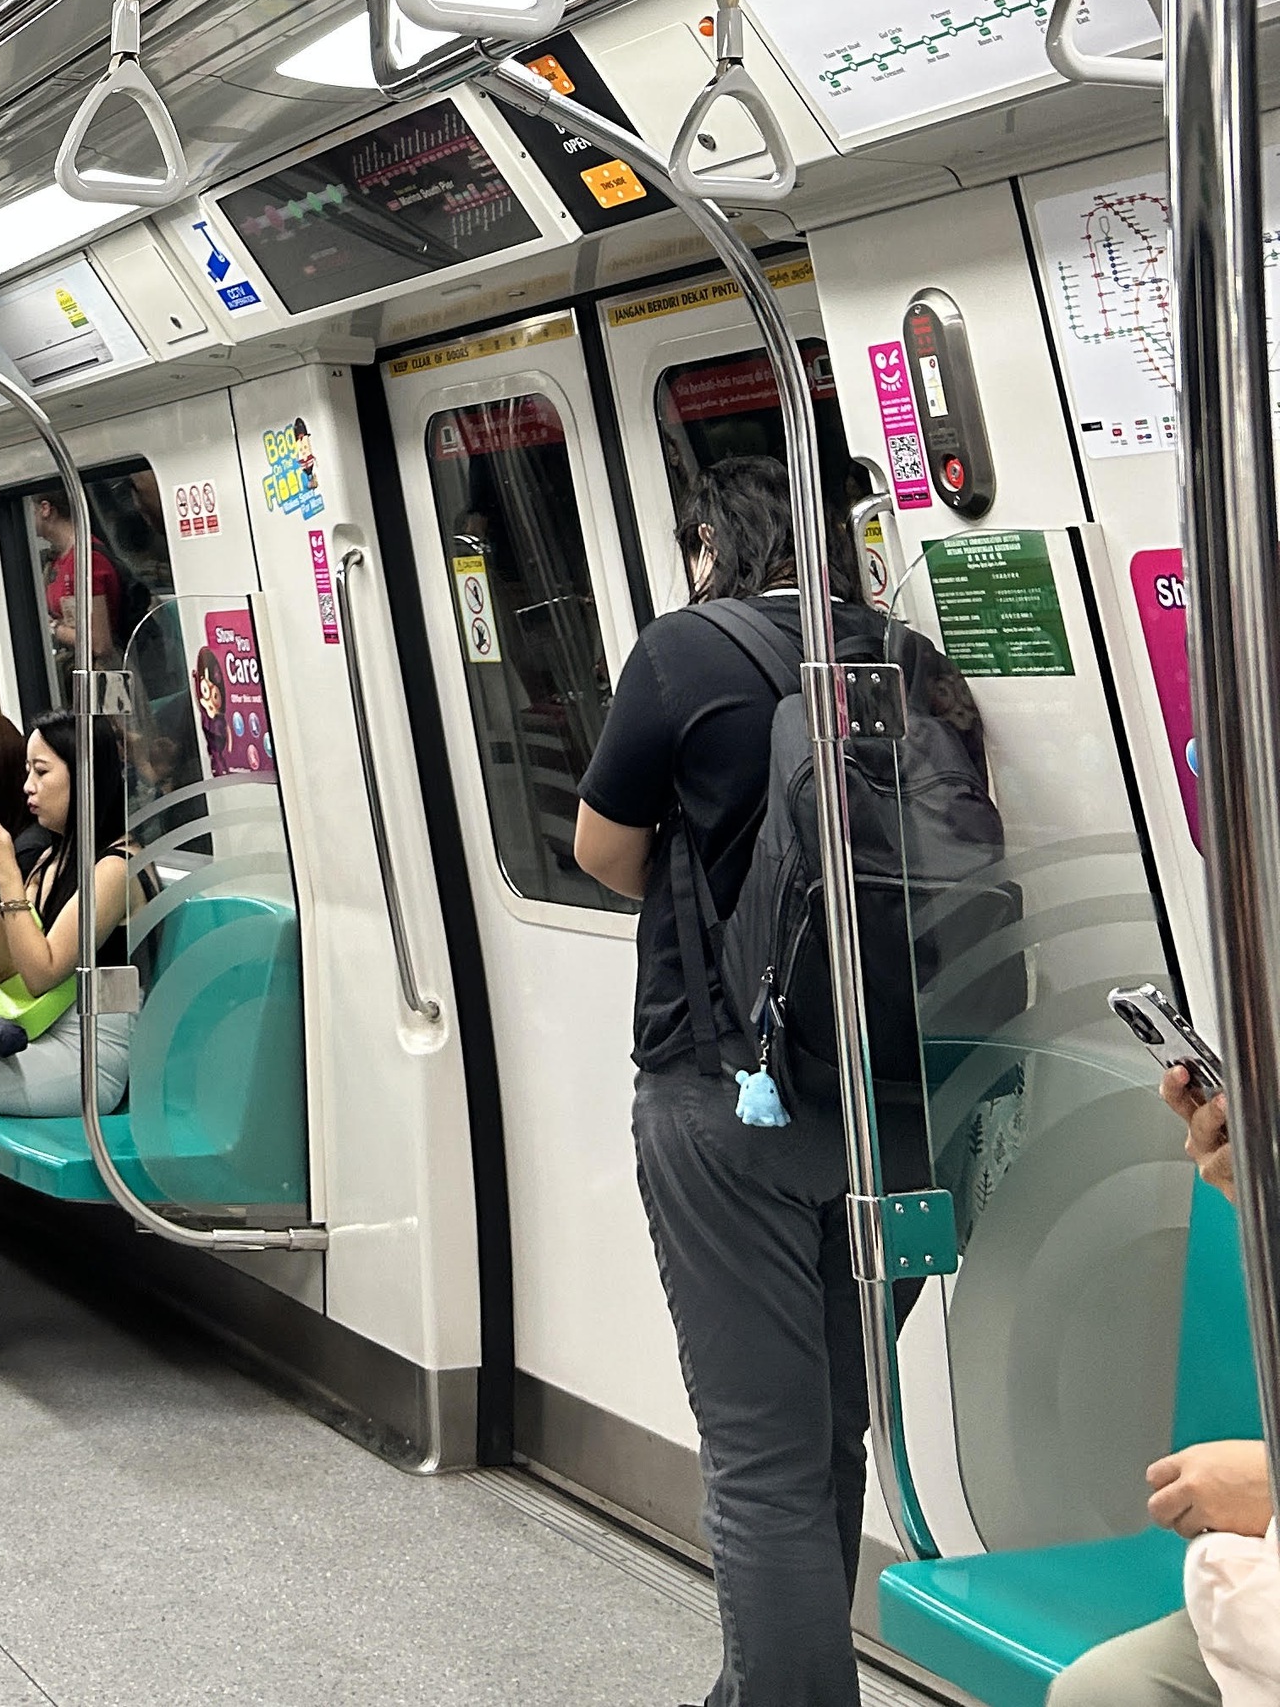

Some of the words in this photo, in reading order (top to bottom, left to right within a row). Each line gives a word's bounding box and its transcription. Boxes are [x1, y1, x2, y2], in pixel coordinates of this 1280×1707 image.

[226, 285, 246, 300] CCTV
[614, 305, 646, 324] JANGAN
[647, 297, 680, 314] BERDIRI
[681, 288, 710, 306] DEKAT
[711, 281, 740, 298] PINTU
[411, 356, 432, 370] CLEAR
[434, 353, 443, 363] OF
[263, 426, 299, 465] Bag
[263, 468, 305, 512] Floor
[215, 625, 235, 644] Show
[234, 634, 251, 652] You
[225, 652, 260, 685] Care
